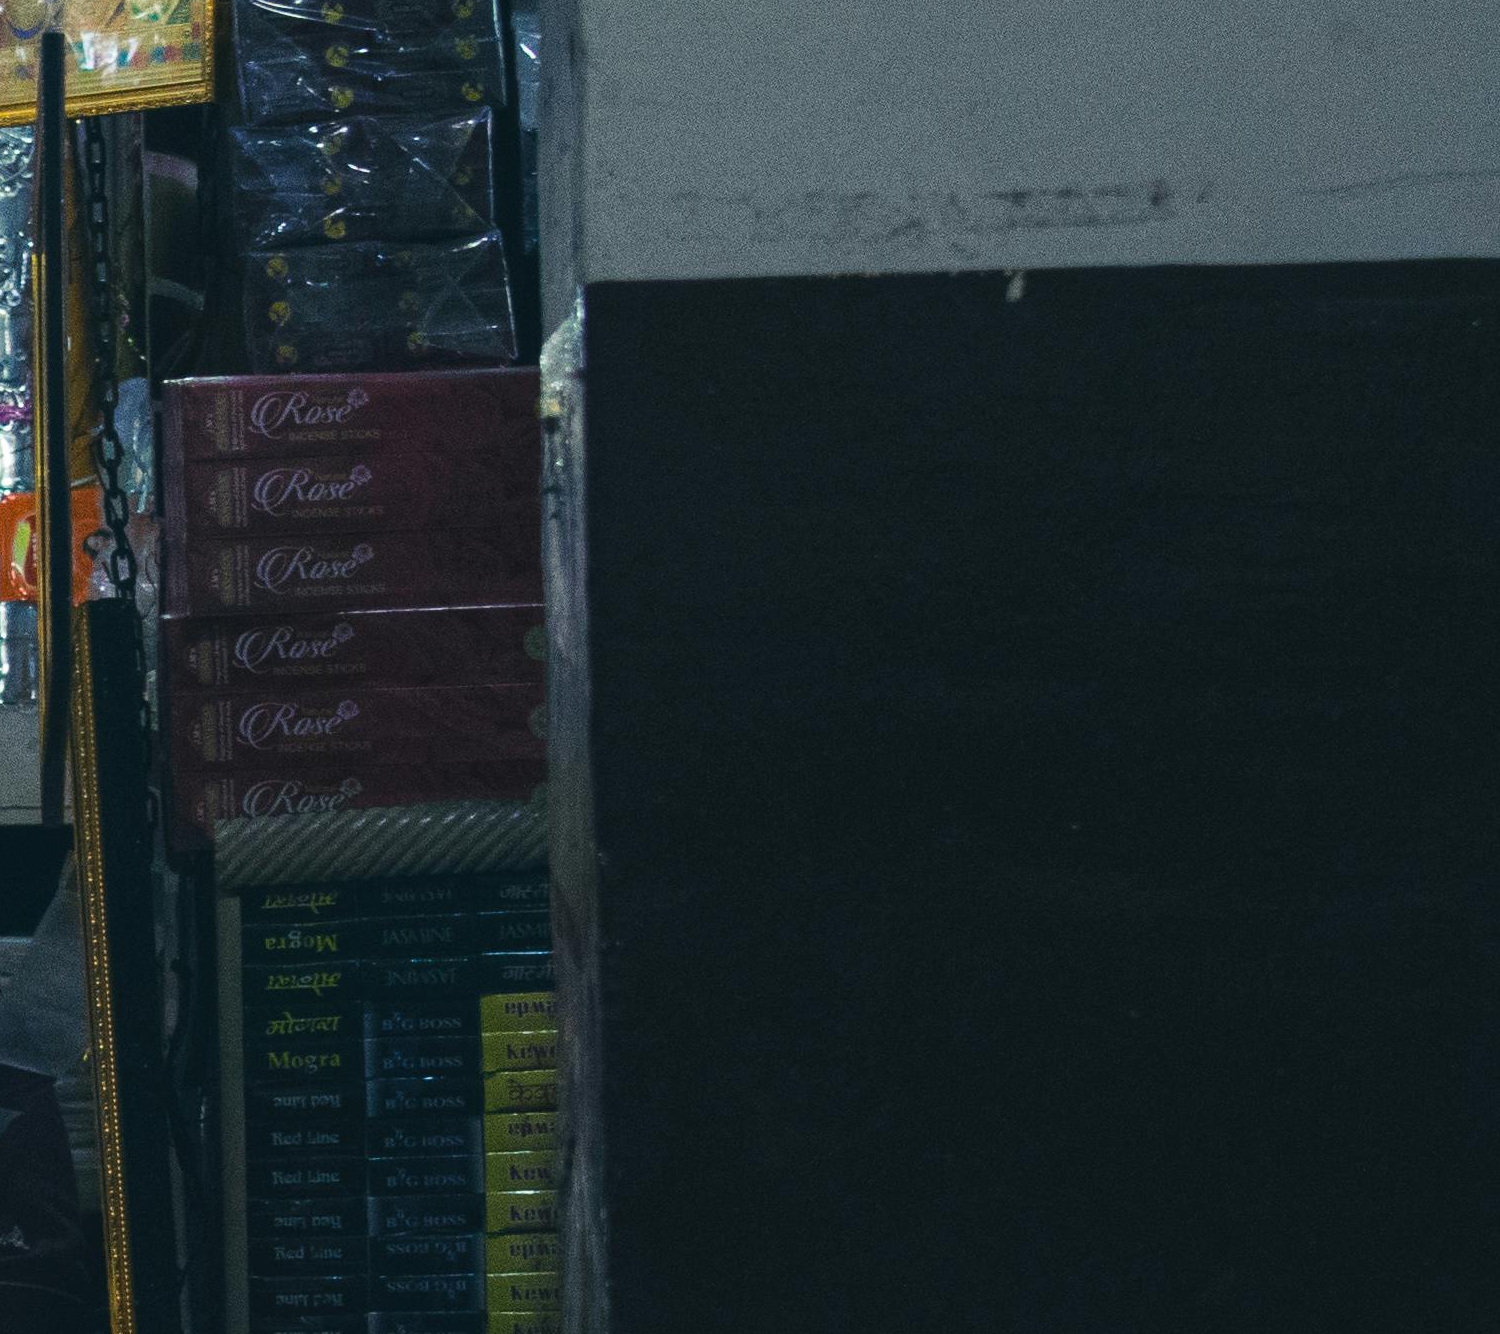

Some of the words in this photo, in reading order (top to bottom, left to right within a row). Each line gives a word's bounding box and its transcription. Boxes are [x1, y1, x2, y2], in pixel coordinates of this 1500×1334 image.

[250, 389, 353, 439] Rose
[253, 467, 356, 517] Rose
[255, 545, 358, 595] Rose
[233, 624, 340, 674] Rose
[238, 701, 342, 750] Rose
[265, 930, 338, 952] Mogra
[381, 929, 452, 946] JASMINE
[499, 923, 549, 940] JASMI
[268, 1050, 341, 1072] Mogra
[270, 1131, 303, 1147] Red
[272, 1171, 304, 1186] Red
[308, 1170, 340, 1183] Line
[274, 1247, 305, 1261] Red
